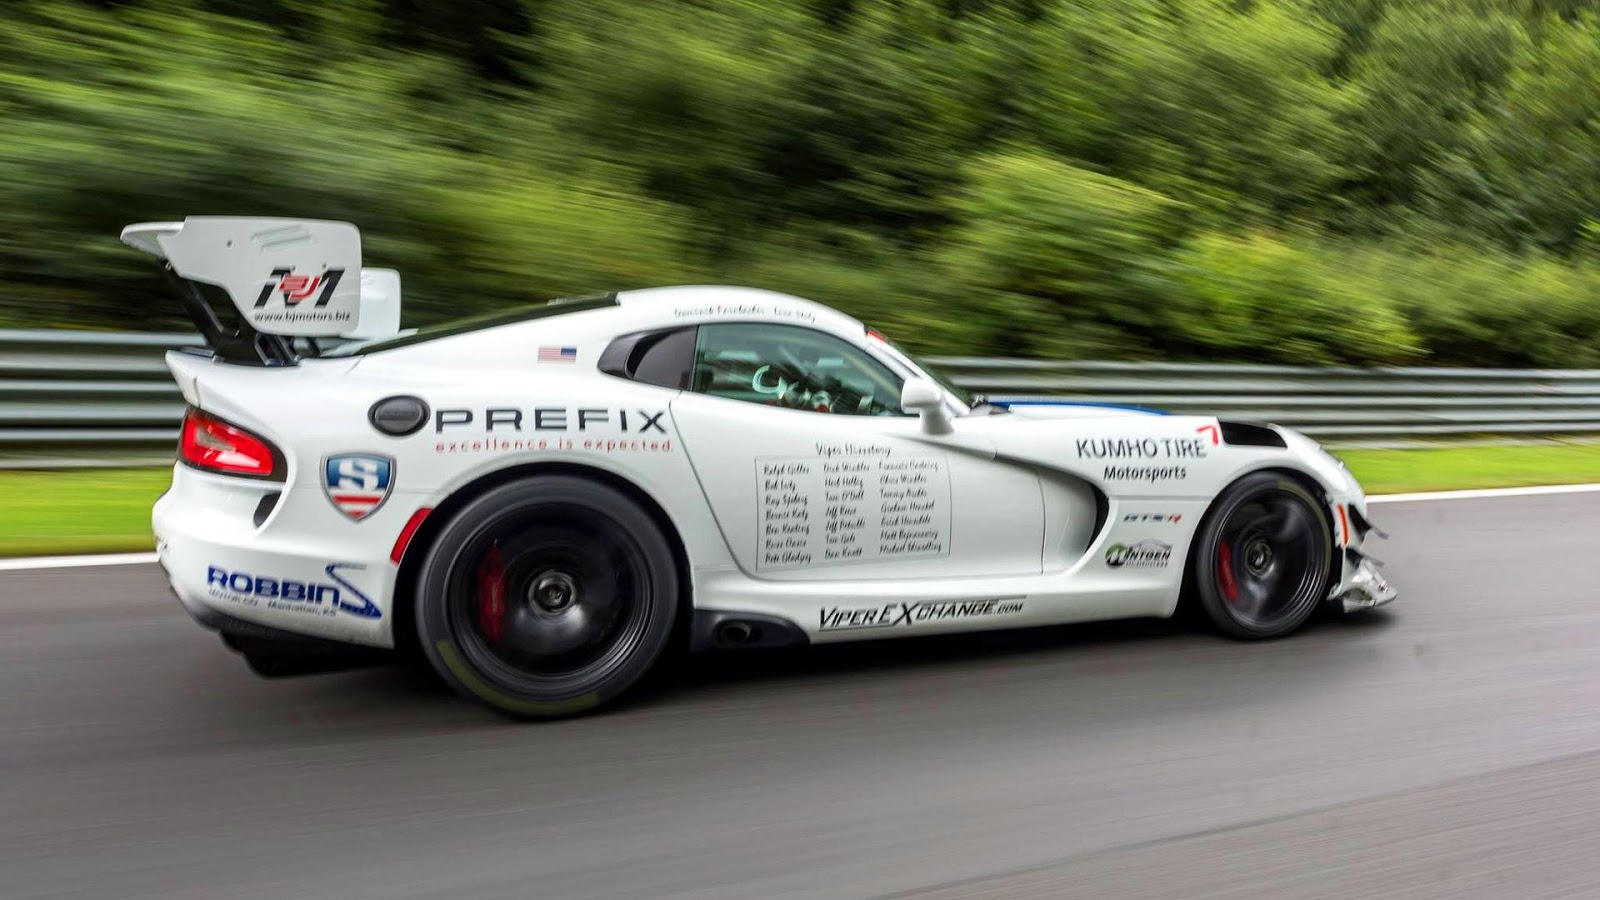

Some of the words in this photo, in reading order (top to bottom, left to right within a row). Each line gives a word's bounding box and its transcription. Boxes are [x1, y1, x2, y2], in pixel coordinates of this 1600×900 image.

[435, 408, 668, 434] PREFIX
[436, 437, 548, 453] excellence
[559, 437, 573, 450] is
[1076, 438, 1158, 458] KUMHO
[1160, 437, 1208, 458] TIRE
[1103, 466, 1186, 483] Motorsports
